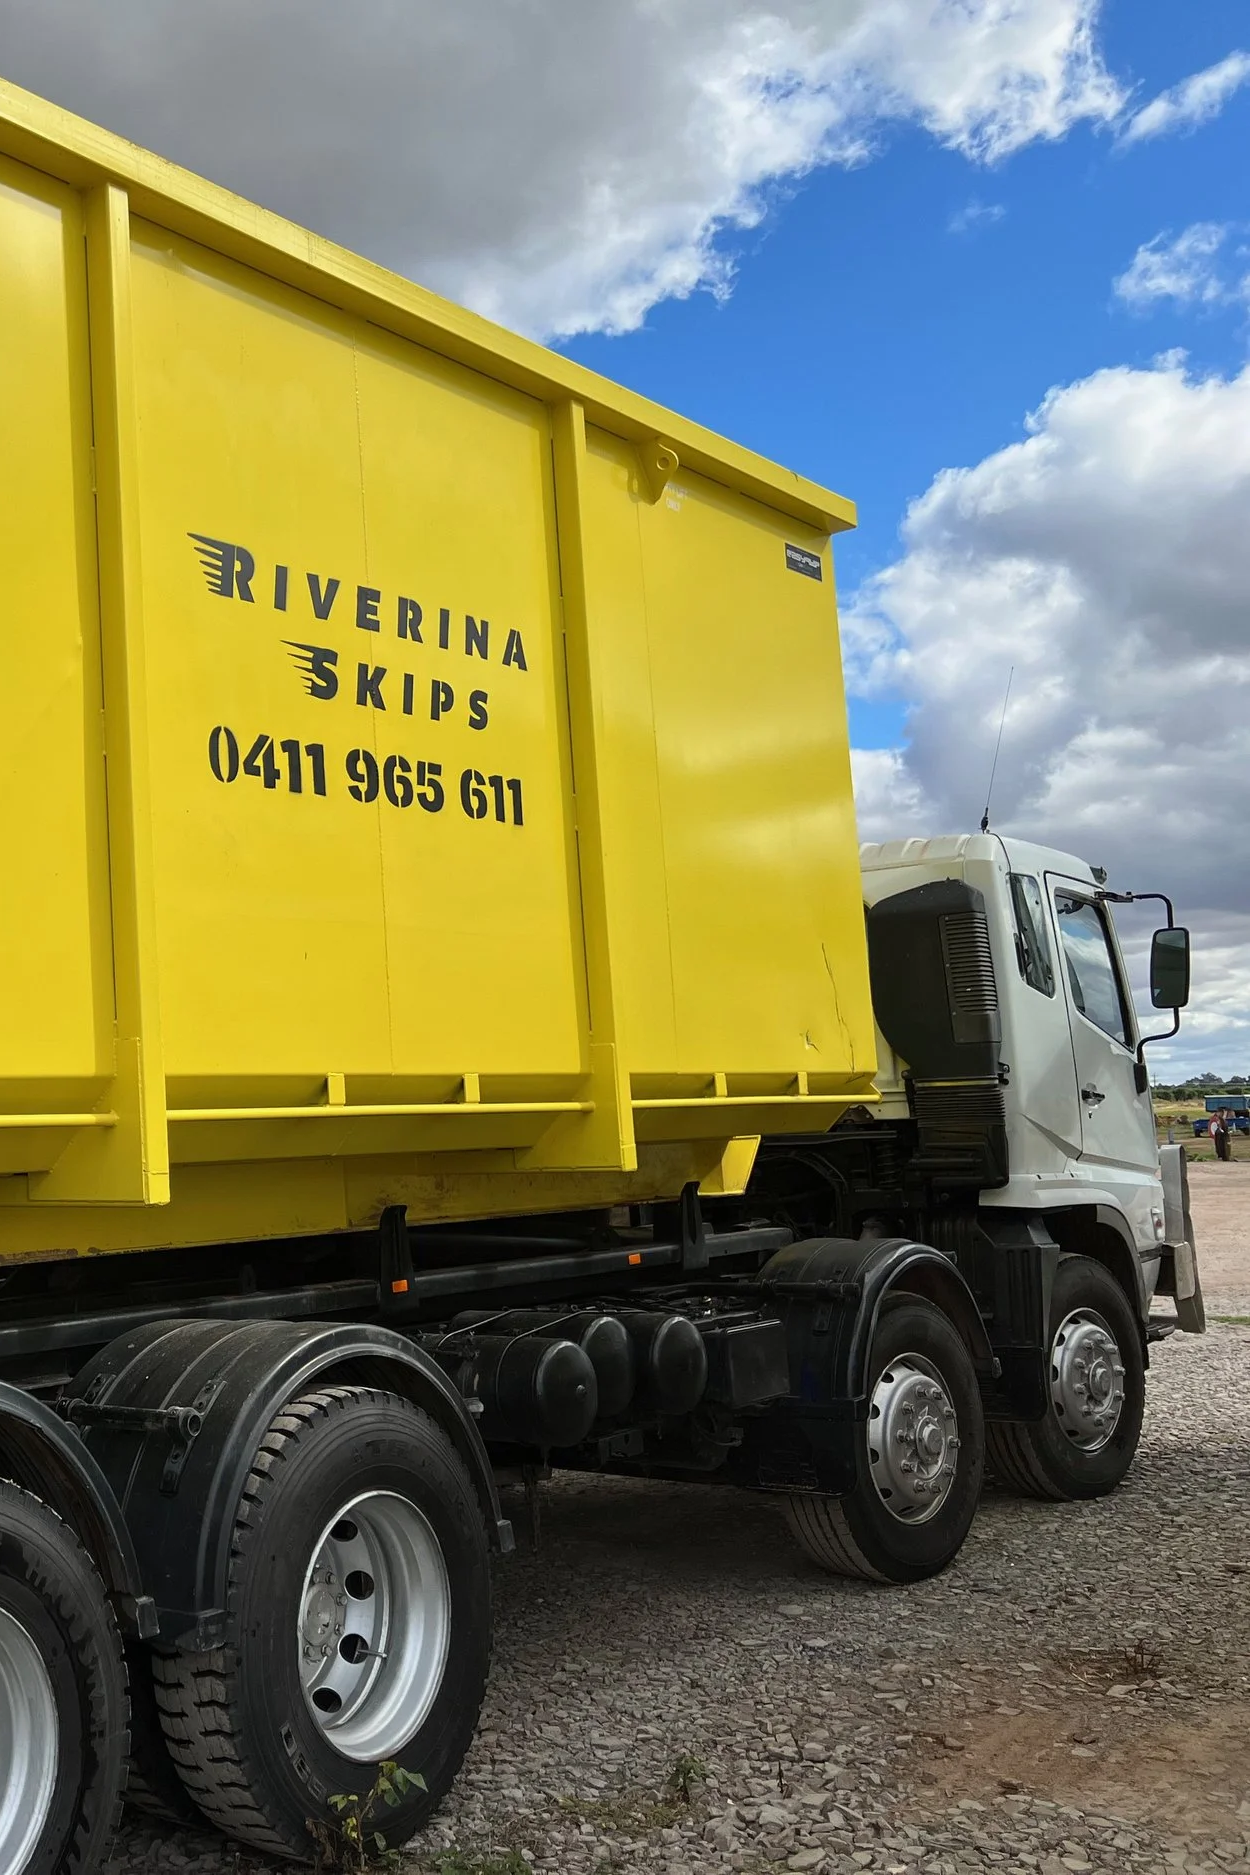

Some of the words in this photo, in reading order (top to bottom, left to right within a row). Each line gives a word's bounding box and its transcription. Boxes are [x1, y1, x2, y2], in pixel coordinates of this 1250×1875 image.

[187, 532, 528, 671] RIVERINA
[280, 640, 489, 730] SKIPS
[208, 725, 327, 797] 0411
[345, 748, 445, 813] 965
[459, 768, 524, 826] 611
